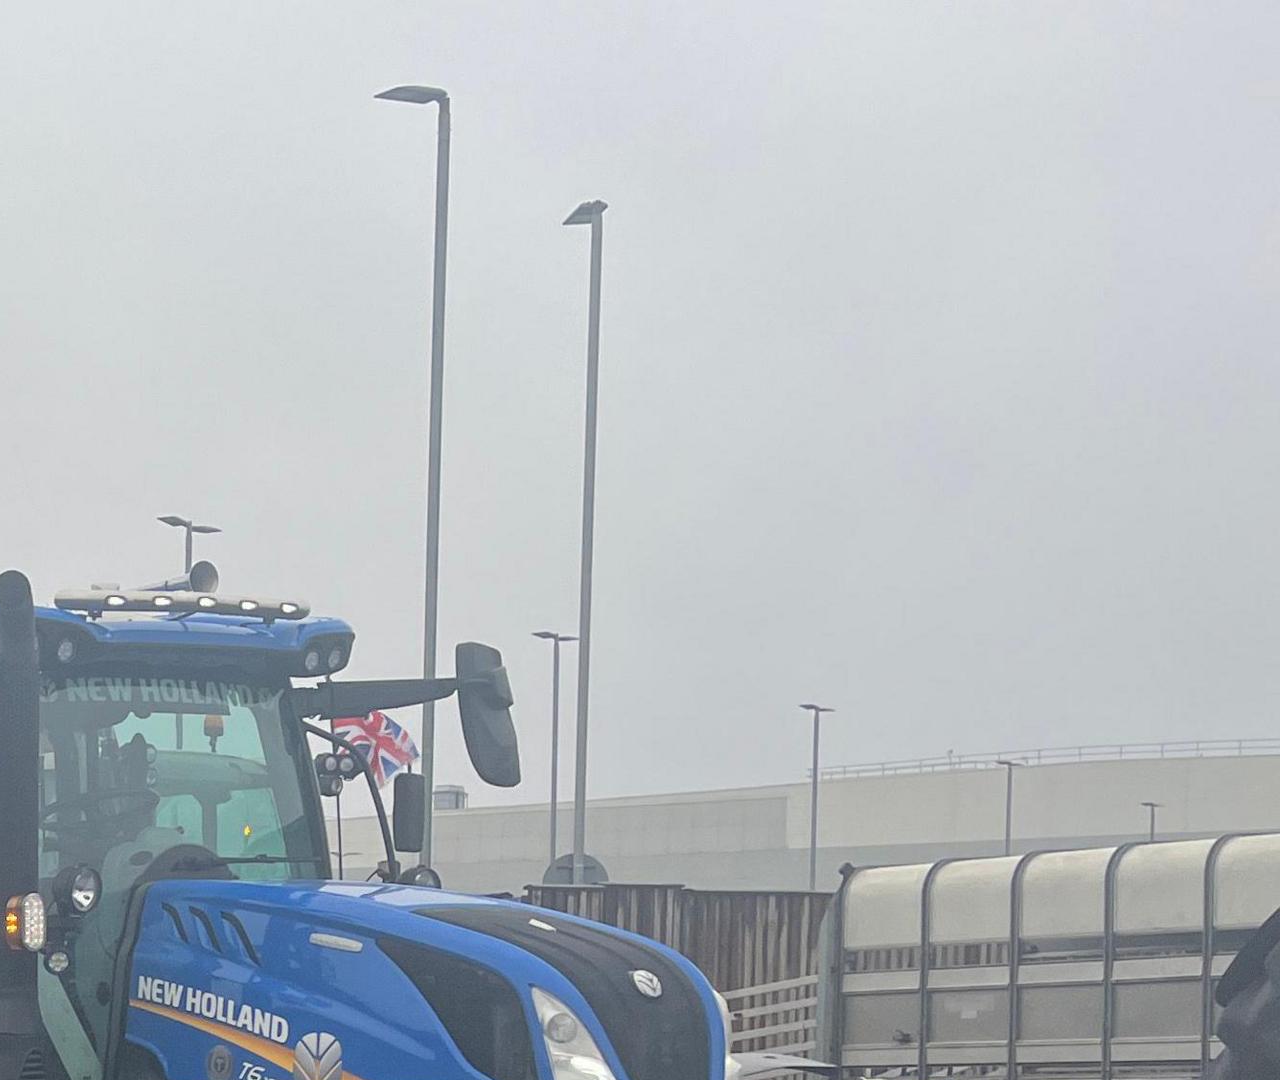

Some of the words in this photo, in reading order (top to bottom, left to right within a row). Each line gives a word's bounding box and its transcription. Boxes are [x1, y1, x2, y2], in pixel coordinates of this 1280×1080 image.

[65, 677, 132, 702] NEW
[140, 678, 253, 706] HOLLAND
[137, 974, 185, 1009] NEW
[185, 985, 290, 1045] HOLLAND
